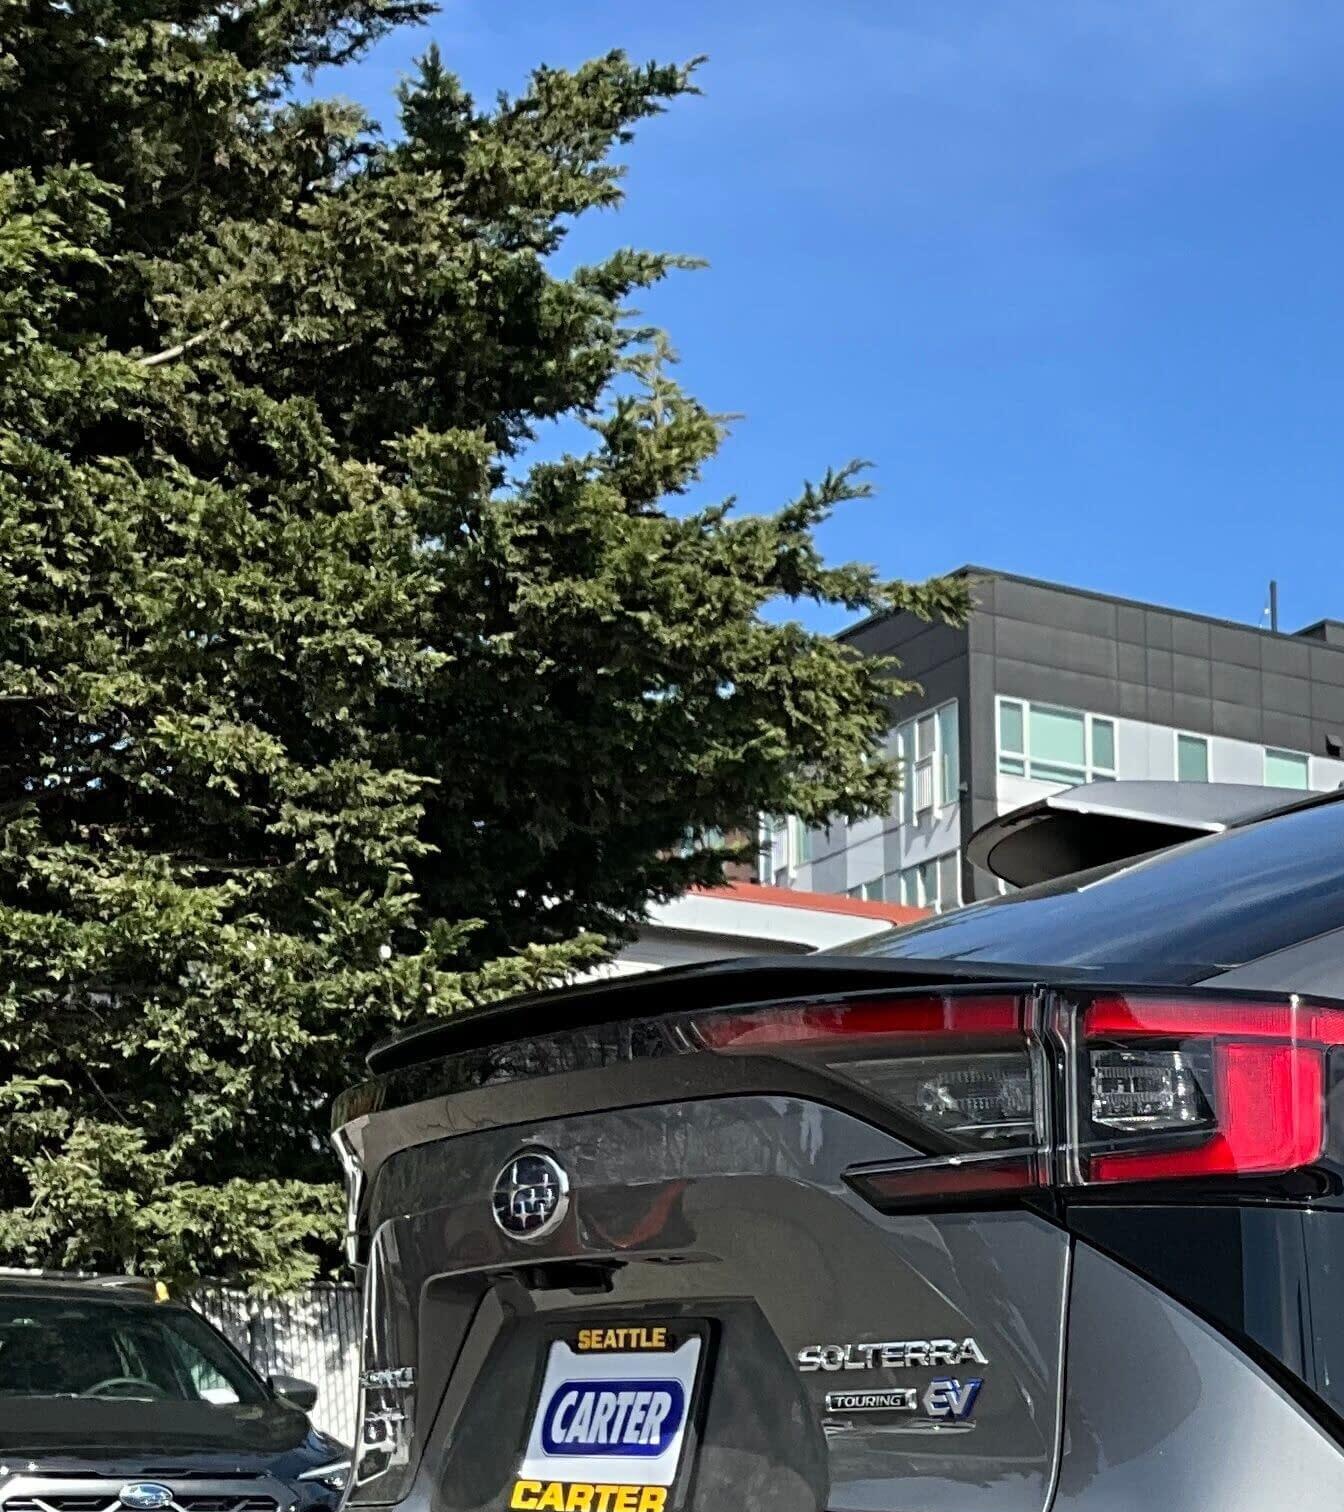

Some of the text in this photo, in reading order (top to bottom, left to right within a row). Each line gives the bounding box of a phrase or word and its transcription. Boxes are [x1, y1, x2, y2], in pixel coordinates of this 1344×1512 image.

[577, 1327, 667, 1350] SEATTLE
[797, 1337, 989, 1372] SOLTERRA
[551, 1390, 673, 1445] CARTER
[835, 1376, 985, 1421] TOURING EV
